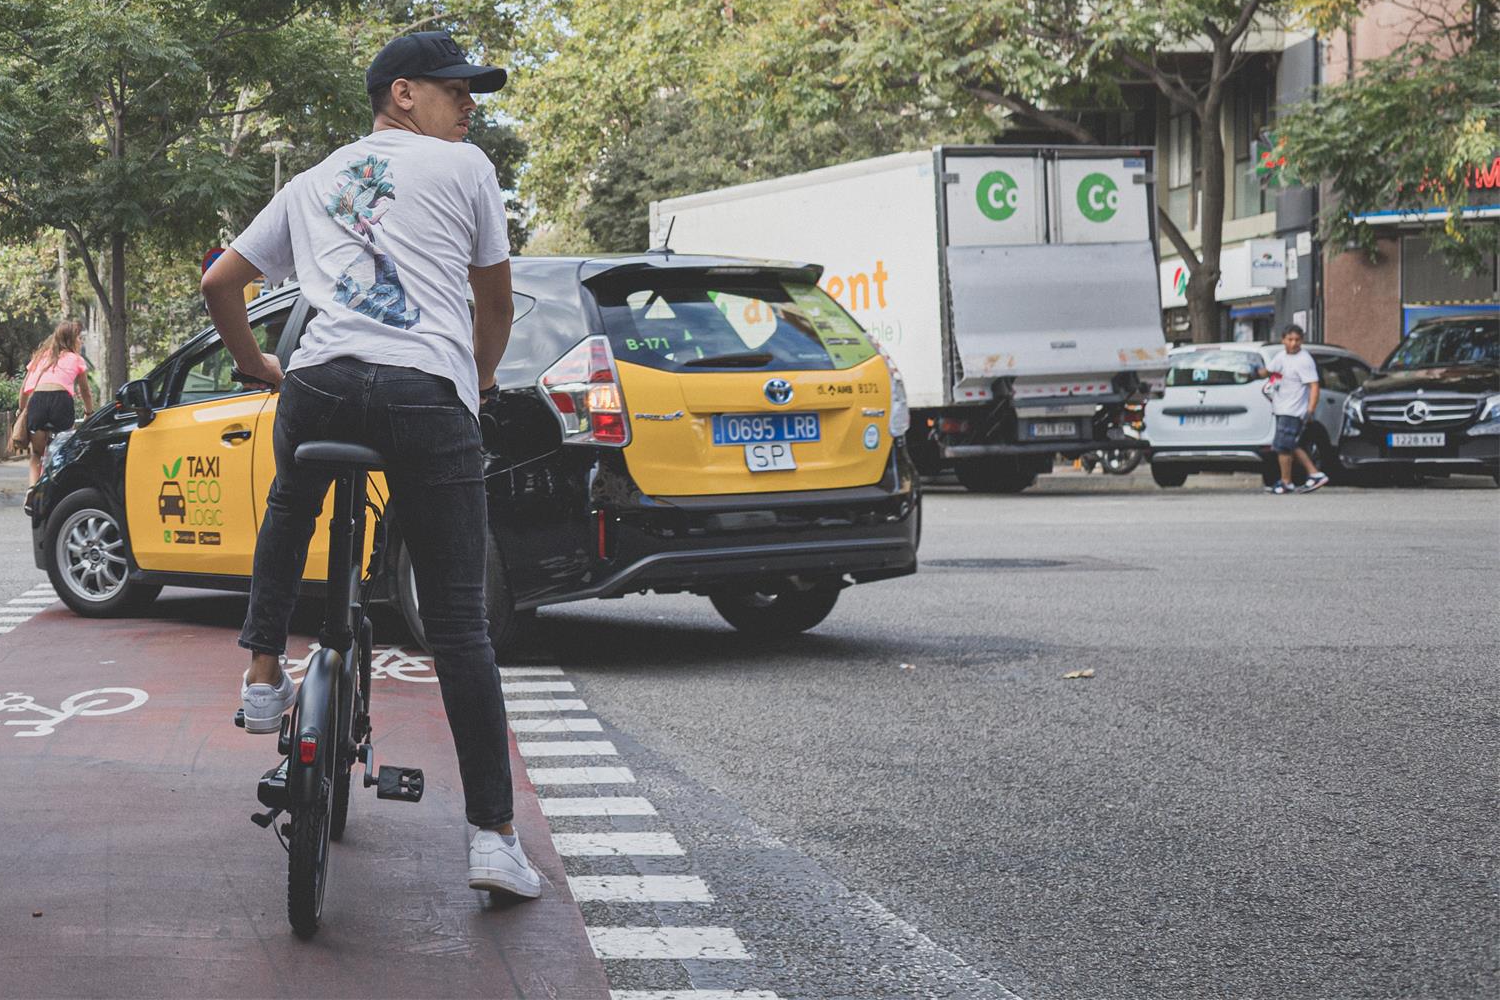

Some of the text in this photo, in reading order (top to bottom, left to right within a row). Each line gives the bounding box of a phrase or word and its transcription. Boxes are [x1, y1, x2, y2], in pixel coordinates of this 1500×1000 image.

[625, 337, 670, 350] B-171
[728, 417, 775, 441] 0695
[784, 415, 817, 439] LRB
[186, 456, 220, 478] TAXI
[752, 444, 786, 468] SP
[187, 480, 221, 503] ECO
